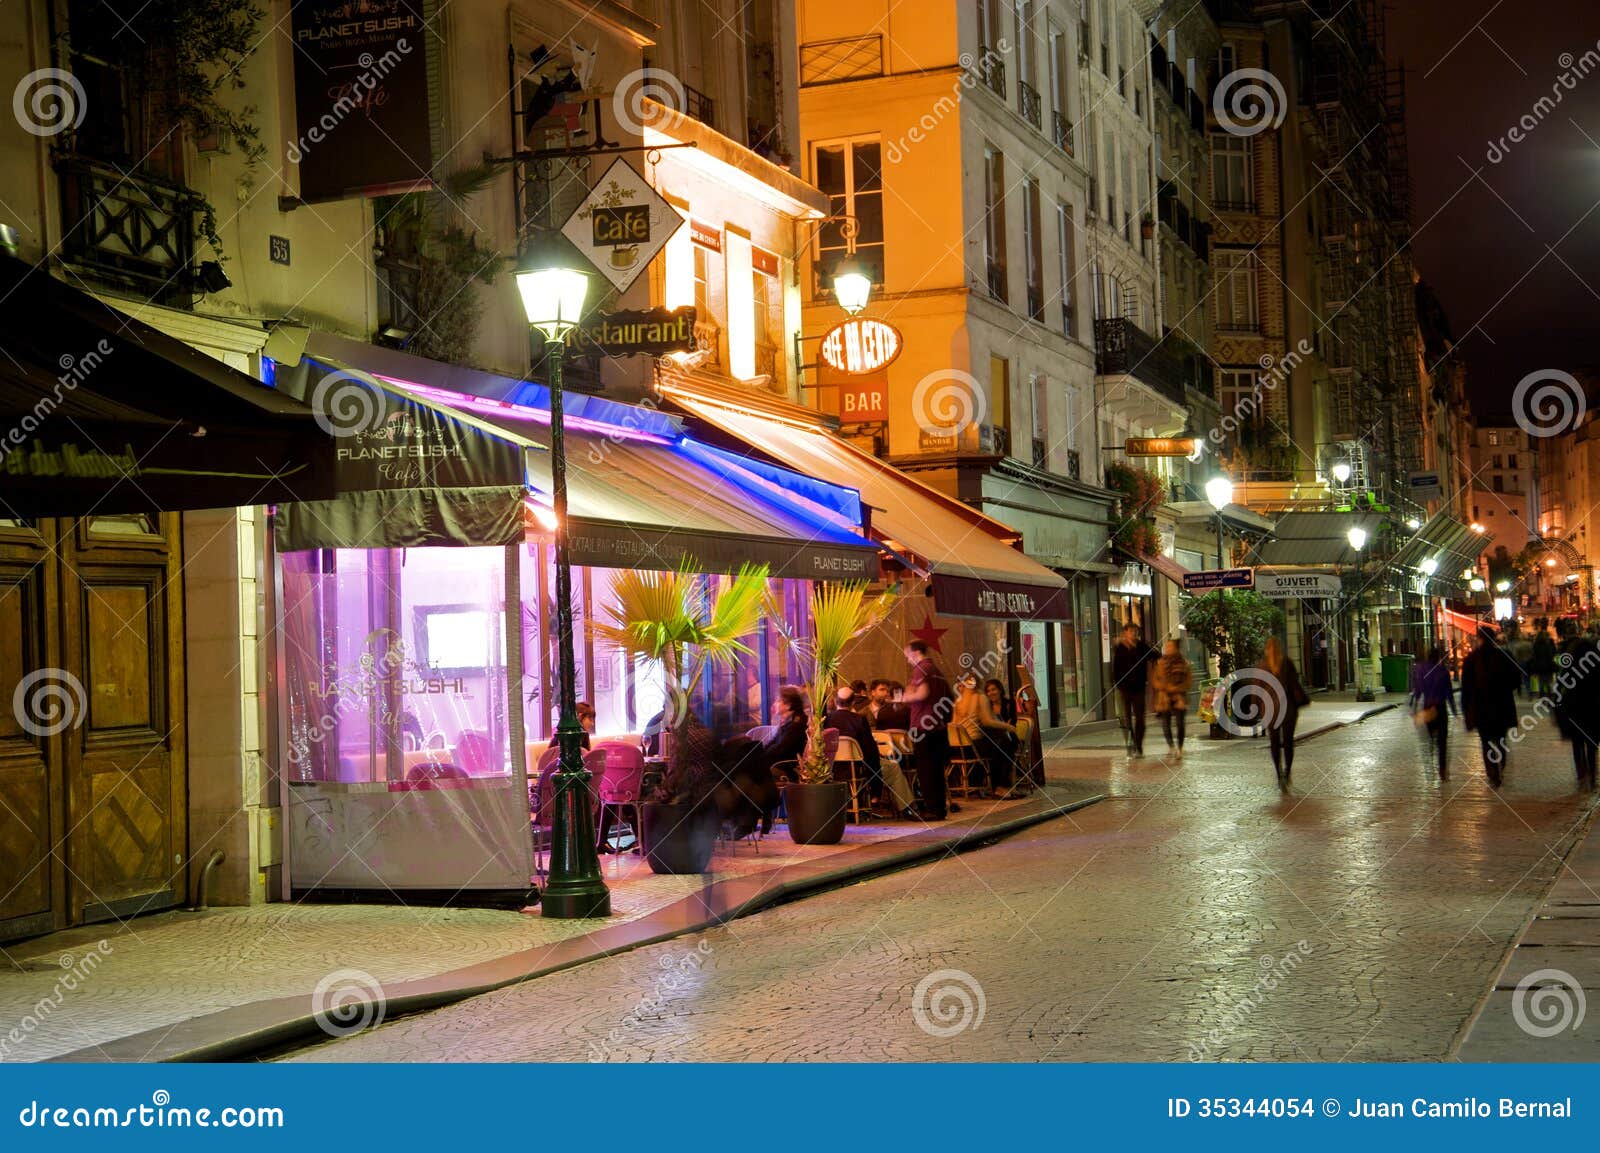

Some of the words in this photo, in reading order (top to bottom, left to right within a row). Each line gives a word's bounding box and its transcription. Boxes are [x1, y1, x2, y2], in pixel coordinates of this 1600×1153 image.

[298, 22, 363, 42] PLANET
[364, 15, 415, 33] SUSHI
[593, 211, 649, 241] Café
[565, 315, 689, 351] Restaurant
[844, 392, 882, 412] BAR
[337, 445, 407, 461] PLANET
[407, 444, 460, 458] SUSHI
[813, 556, 842, 570] PLANET
[842, 558, 865, 571] SUSHI
[1275, 576, 1320, 587] OUVERT
[1305, 589, 1335, 597] TRAVAUX
[308, 679, 391, 699] PLANET
[393, 677, 464, 695] SUSHI
